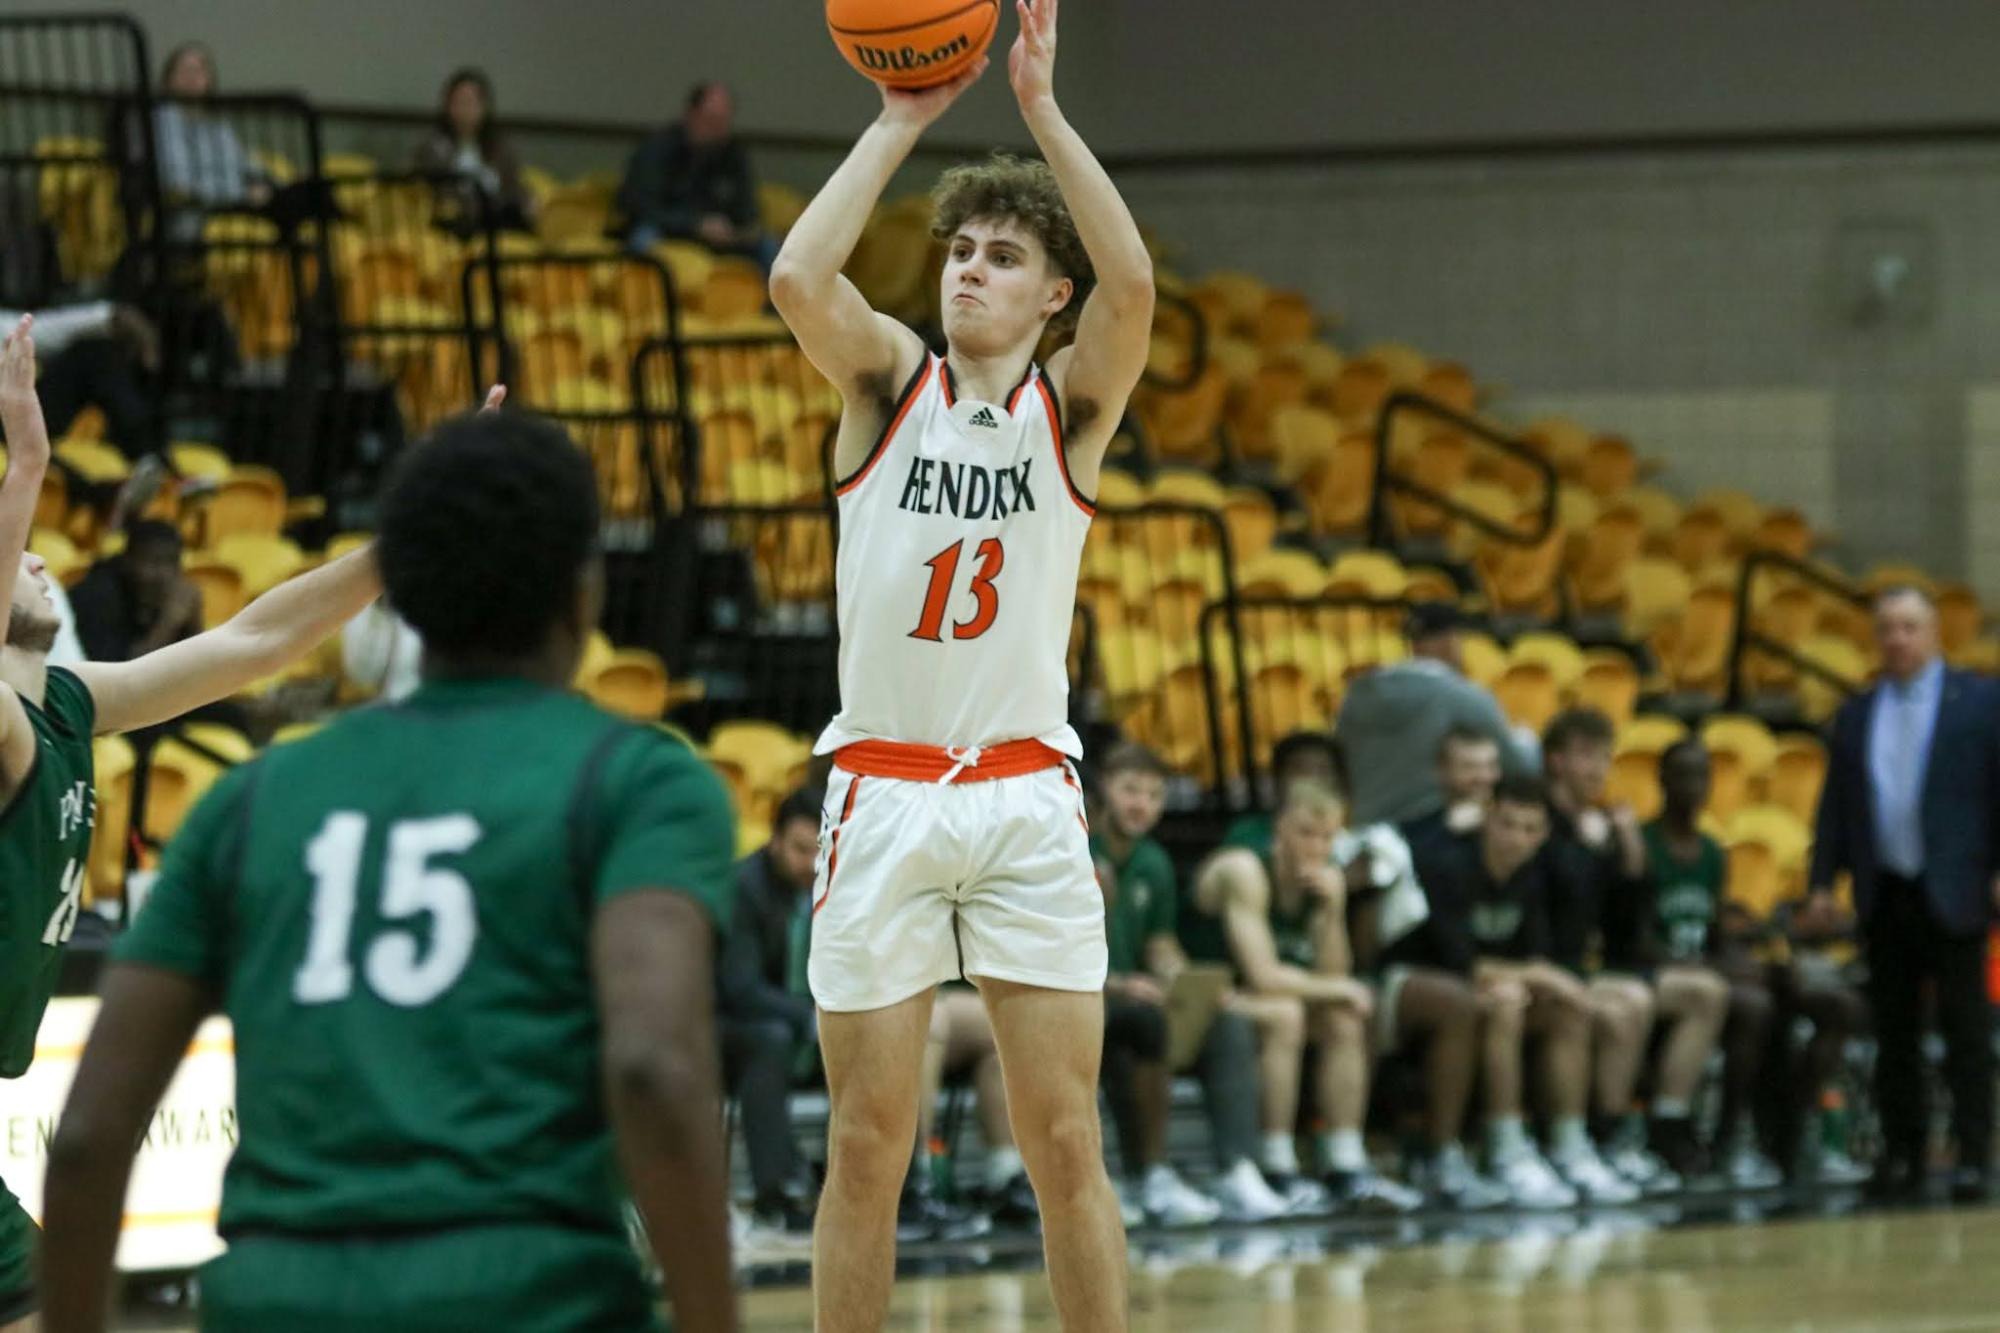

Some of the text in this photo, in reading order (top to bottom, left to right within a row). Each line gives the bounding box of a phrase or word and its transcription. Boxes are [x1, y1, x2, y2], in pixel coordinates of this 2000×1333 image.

[852, 34, 969, 71] Wilson
[968, 418, 999, 429] adidas
[898, 455, 1036, 521] HENDRX
[906, 537, 1005, 643] 13
[293, 810, 483, 1007] 15
